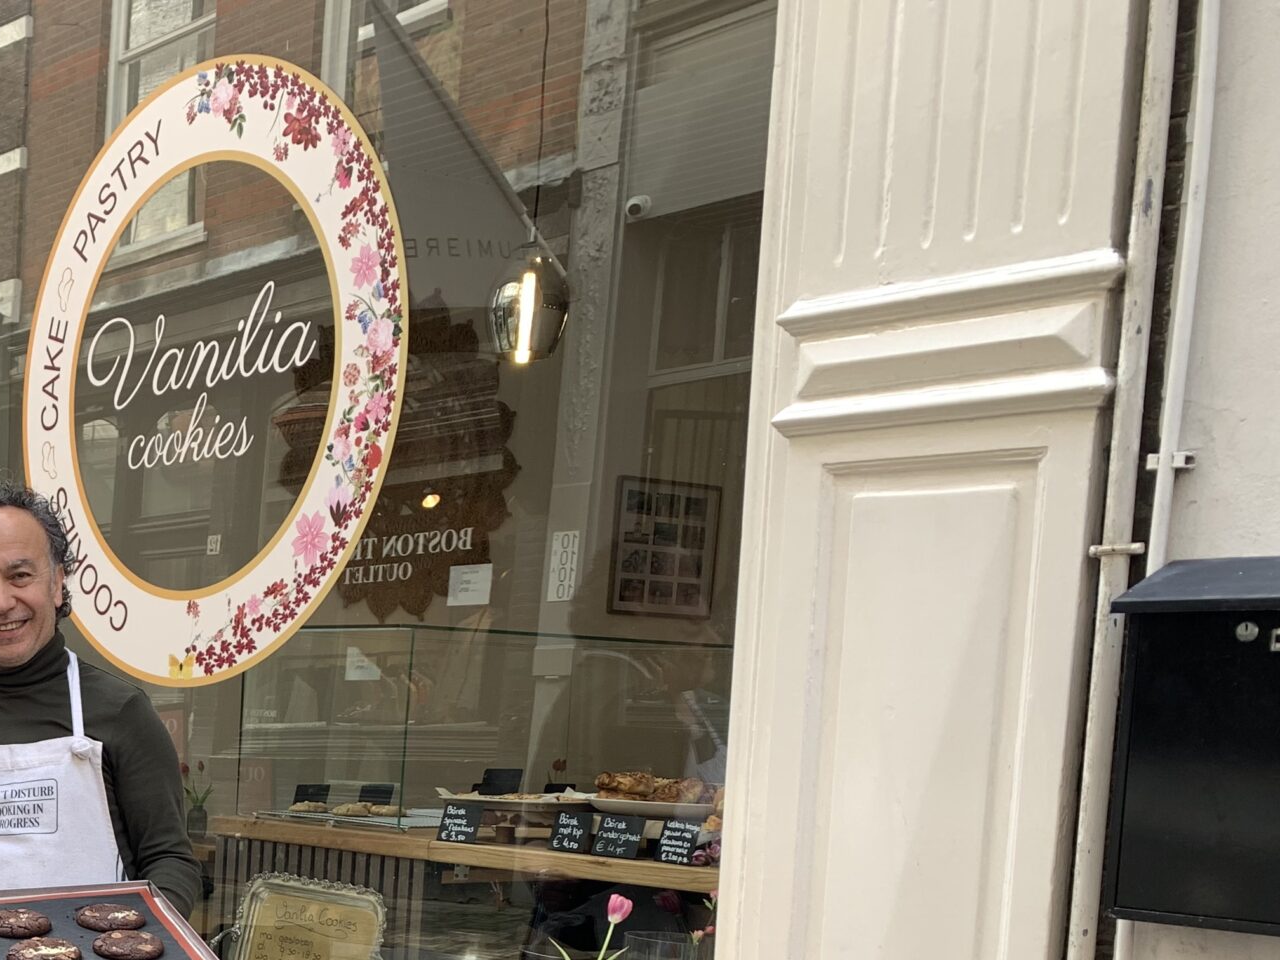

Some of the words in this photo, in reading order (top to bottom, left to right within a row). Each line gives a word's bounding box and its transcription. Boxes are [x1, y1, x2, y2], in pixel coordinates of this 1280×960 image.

[40, 317, 69, 431] CAKE
[72, 119, 163, 263] PASTRY
[87, 281, 317, 410] Vanilia
[128, 392, 255, 469] cookies
[10, 786, 54, 799] DISTURB
[32, 803, 44, 815] IN
[603, 817, 627, 829] Börek
[319, 907, 358, 933] Cookies
